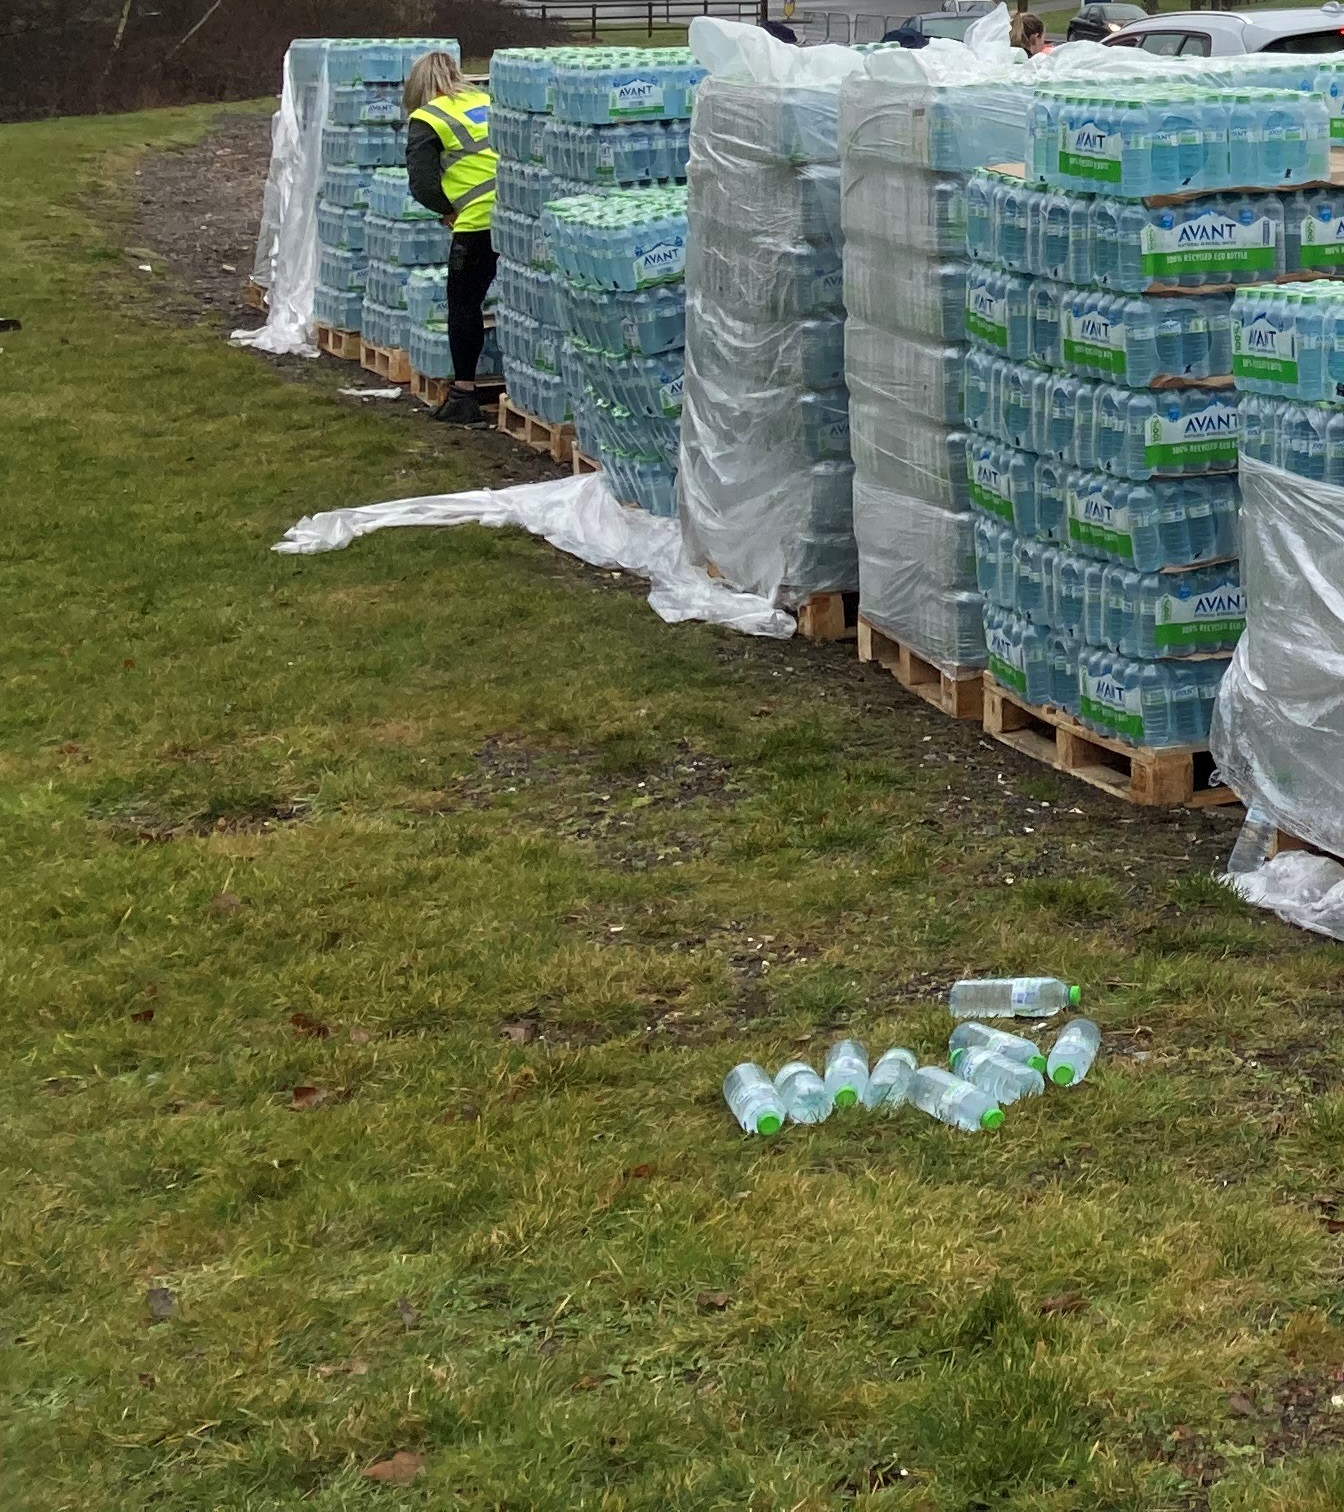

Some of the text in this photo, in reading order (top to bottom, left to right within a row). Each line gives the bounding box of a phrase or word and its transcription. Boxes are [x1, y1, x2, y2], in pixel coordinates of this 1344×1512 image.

[618, 85, 653, 98] AVANT
[1179, 223, 1237, 242] AVANT
[643, 248, 679, 267] AVANT
[1185, 413, 1238, 433] AVANT
[1195, 595, 1241, 614] AVAN
